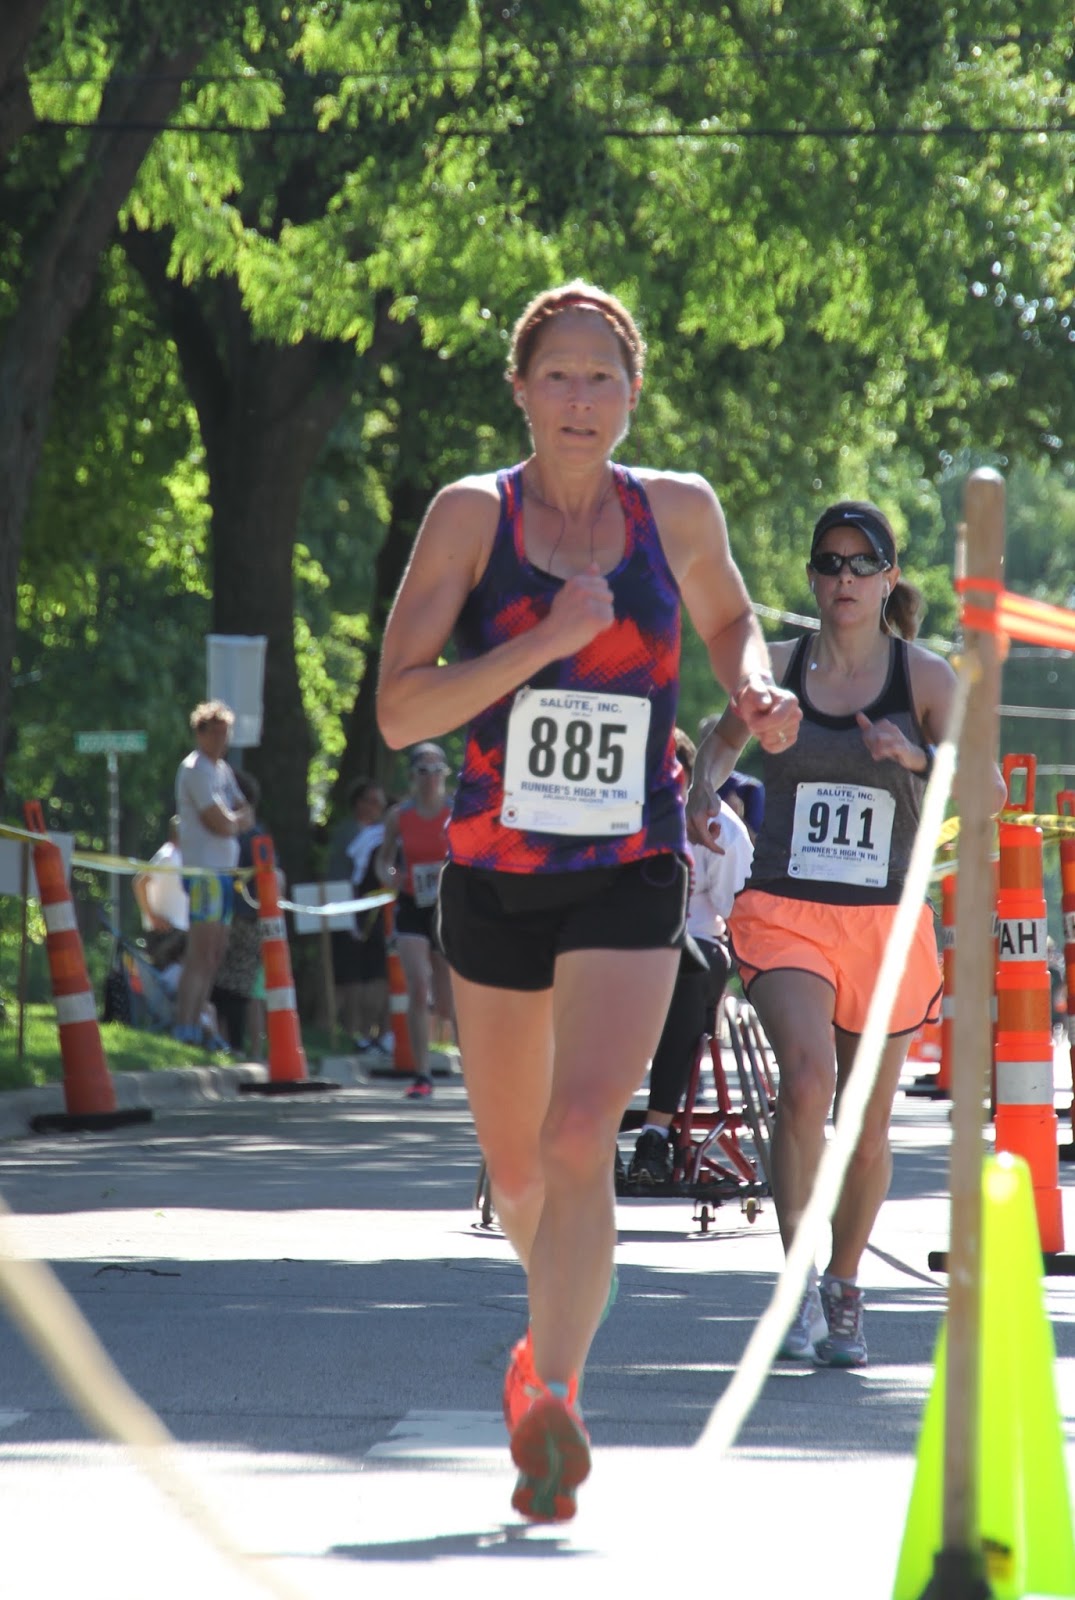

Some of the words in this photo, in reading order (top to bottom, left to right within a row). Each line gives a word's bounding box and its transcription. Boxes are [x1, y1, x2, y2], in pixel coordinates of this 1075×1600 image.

[540, 698, 593, 712] SALUTE,
[597, 702, 622, 713] INC.
[528, 716, 627, 784] 885
[520, 781, 570, 796] RUNNER'S
[573, 786, 597, 798] HIGH
[612, 789, 628, 800] TRI
[817, 788, 854, 799] SALUTE,
[858, 791, 875, 801] INC.
[808, 802, 874, 849] 911
[801, 846, 837, 855] RUNNER'S
[840, 849, 856, 857] HIGH
[999, 920, 1038, 955] AH
